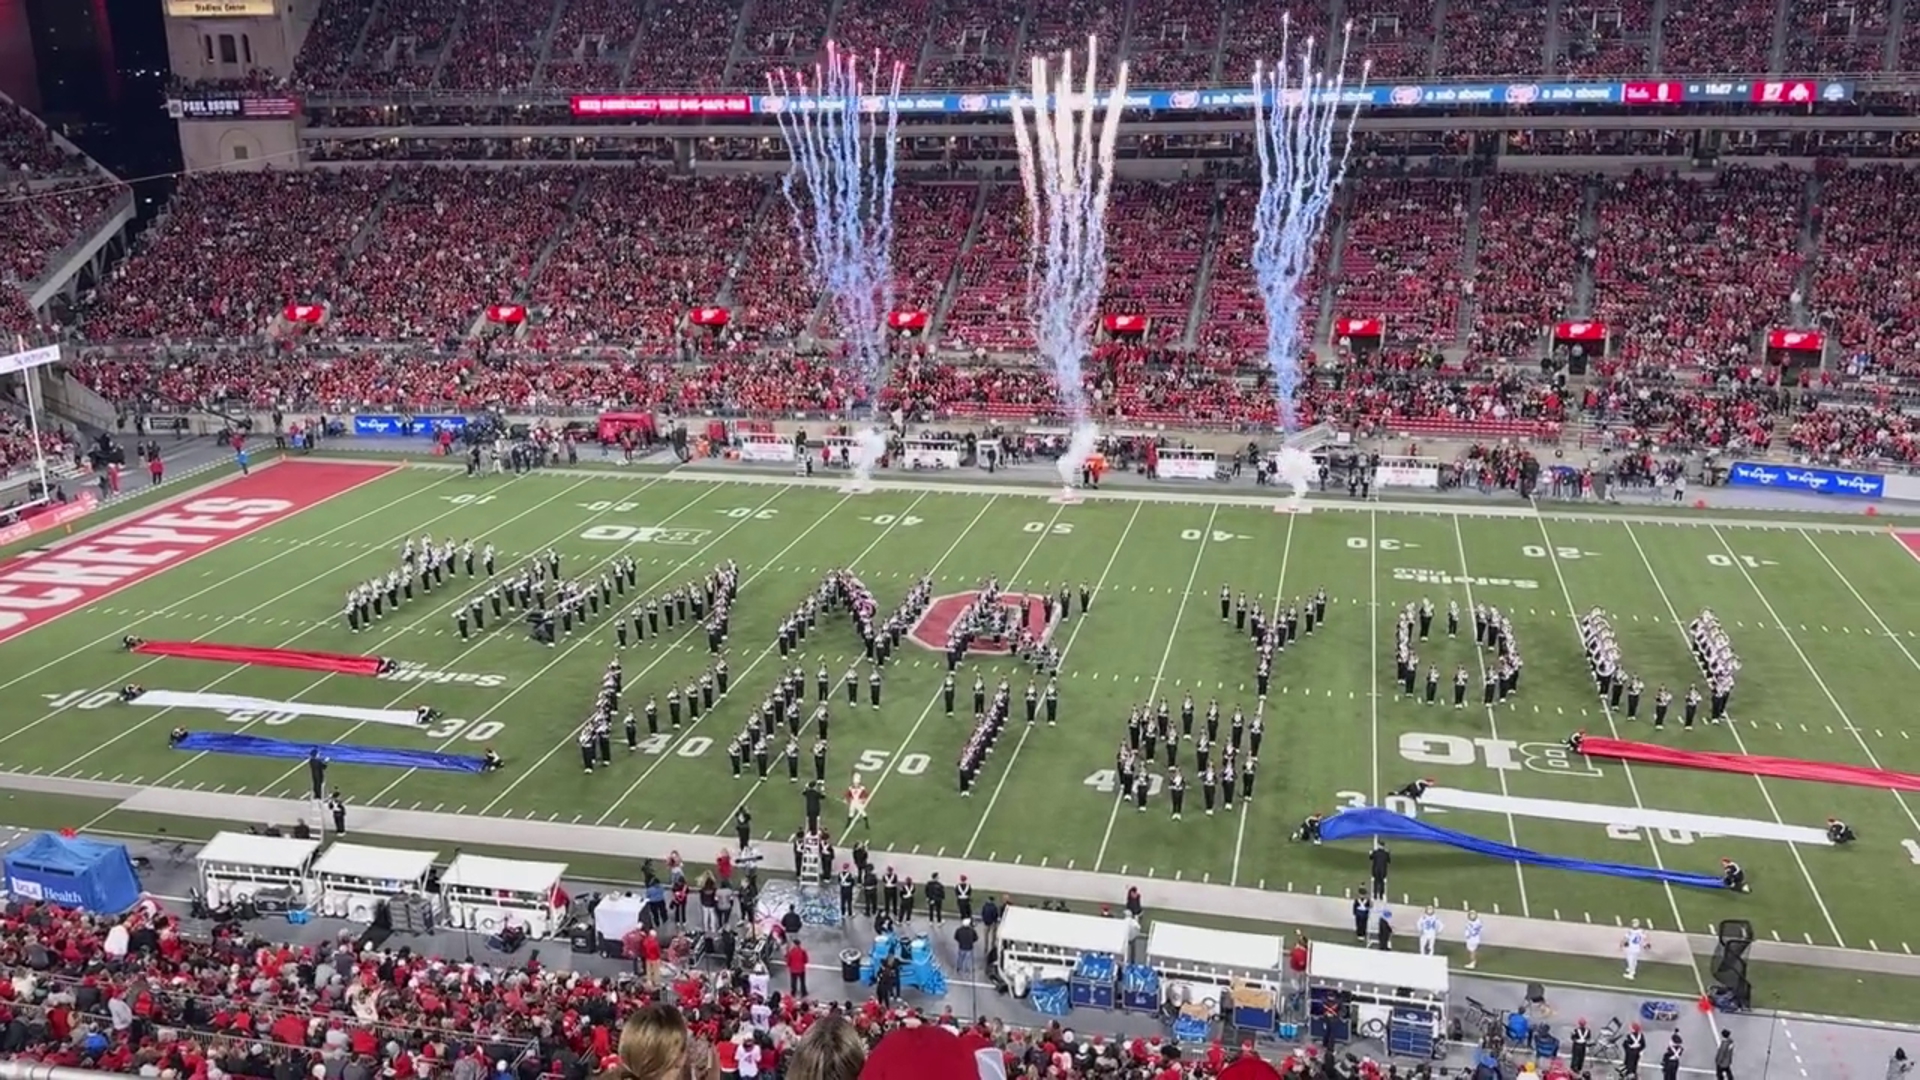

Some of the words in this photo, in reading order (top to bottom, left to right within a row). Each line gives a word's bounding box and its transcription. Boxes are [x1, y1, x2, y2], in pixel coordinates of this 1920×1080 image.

[48, 688, 120, 709] 10
[427, 719, 506, 741] 30
[635, 733, 714, 757] 40
[854, 750, 931, 775] 50
[16, 881, 39, 896] UCLA
[43, 887, 83, 904] Health
